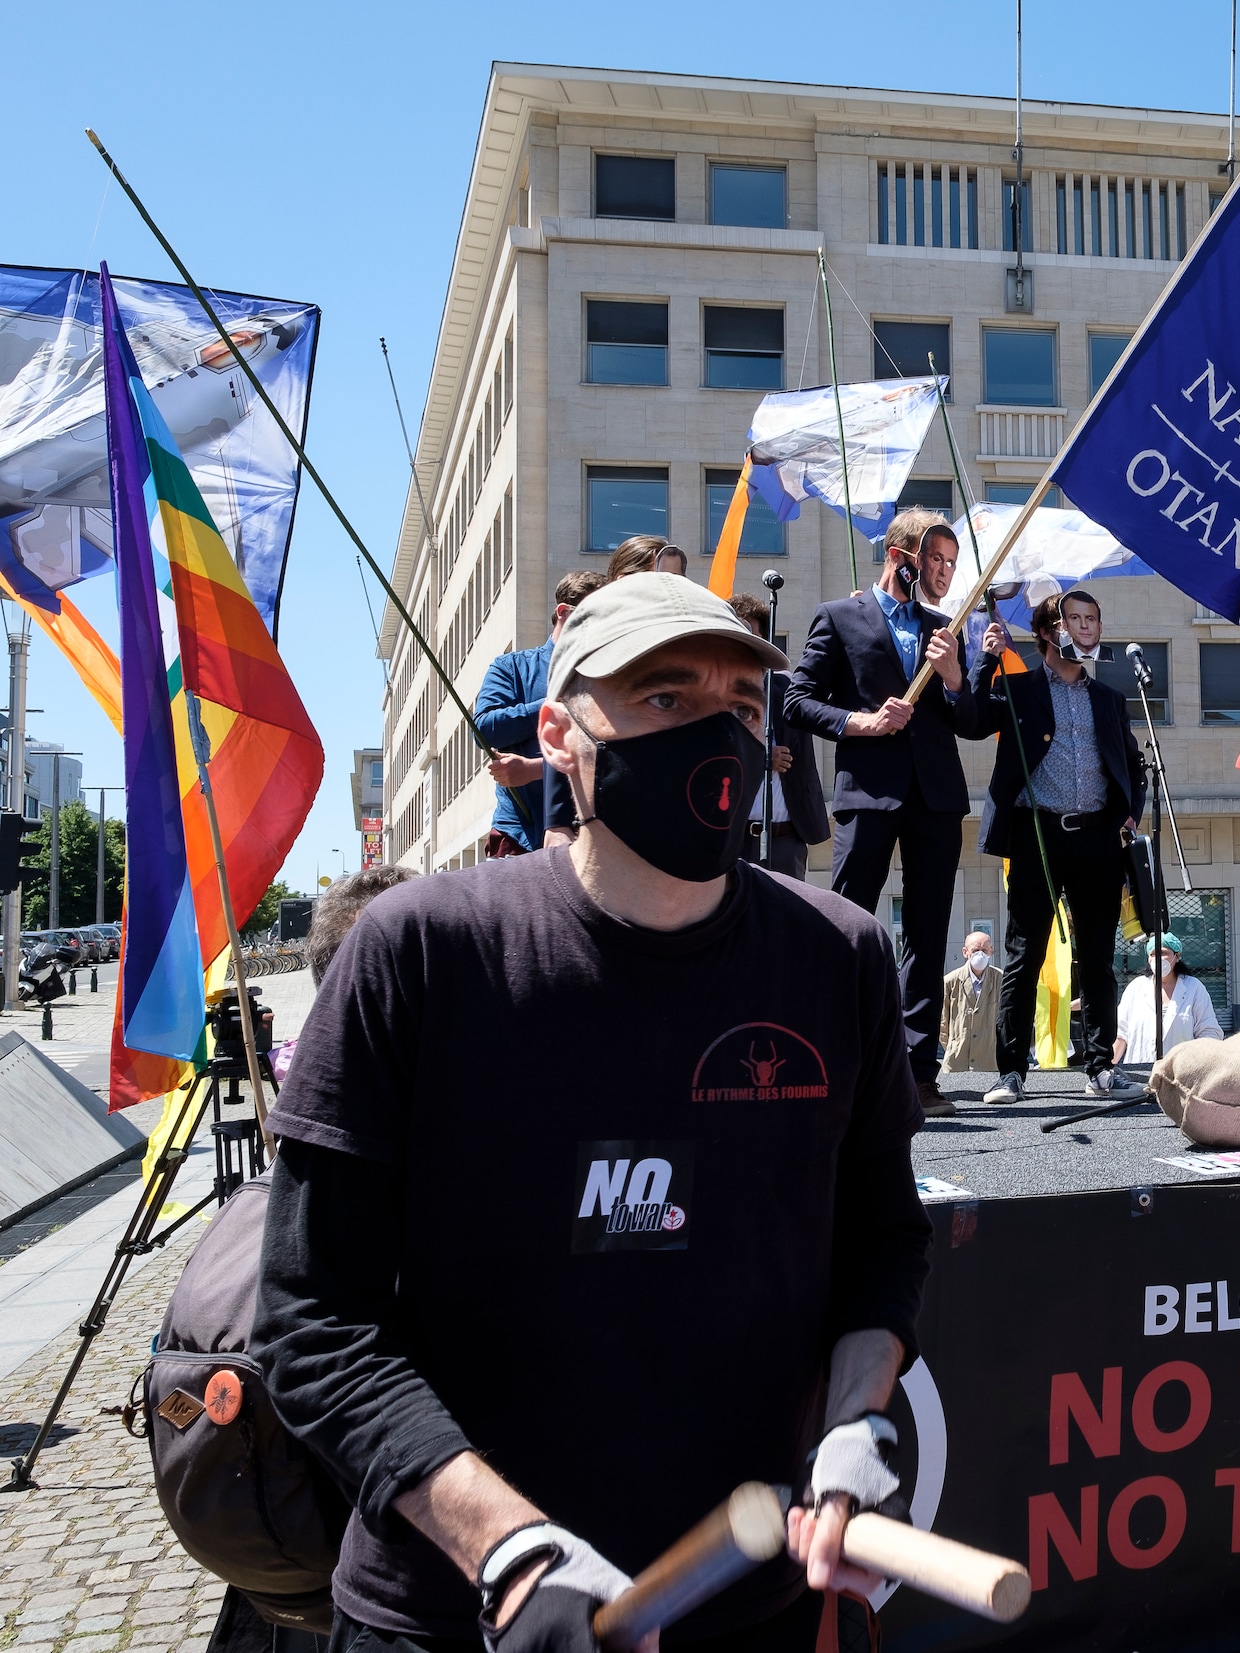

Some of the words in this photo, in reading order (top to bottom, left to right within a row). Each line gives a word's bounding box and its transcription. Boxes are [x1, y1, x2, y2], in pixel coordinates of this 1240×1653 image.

[692, 1089, 705, 1102] LE
[707, 1088, 756, 1102] RYTHME
[757, 1087, 779, 1100] DES
[781, 1085, 829, 1099] FOURMIS
[578, 1157, 673, 1218] NO
[606, 1196, 630, 1233] to
[628, 1202, 673, 1232] war
[1049, 1360, 1212, 1466] NO
[1028, 1475, 1187, 1592] NO
